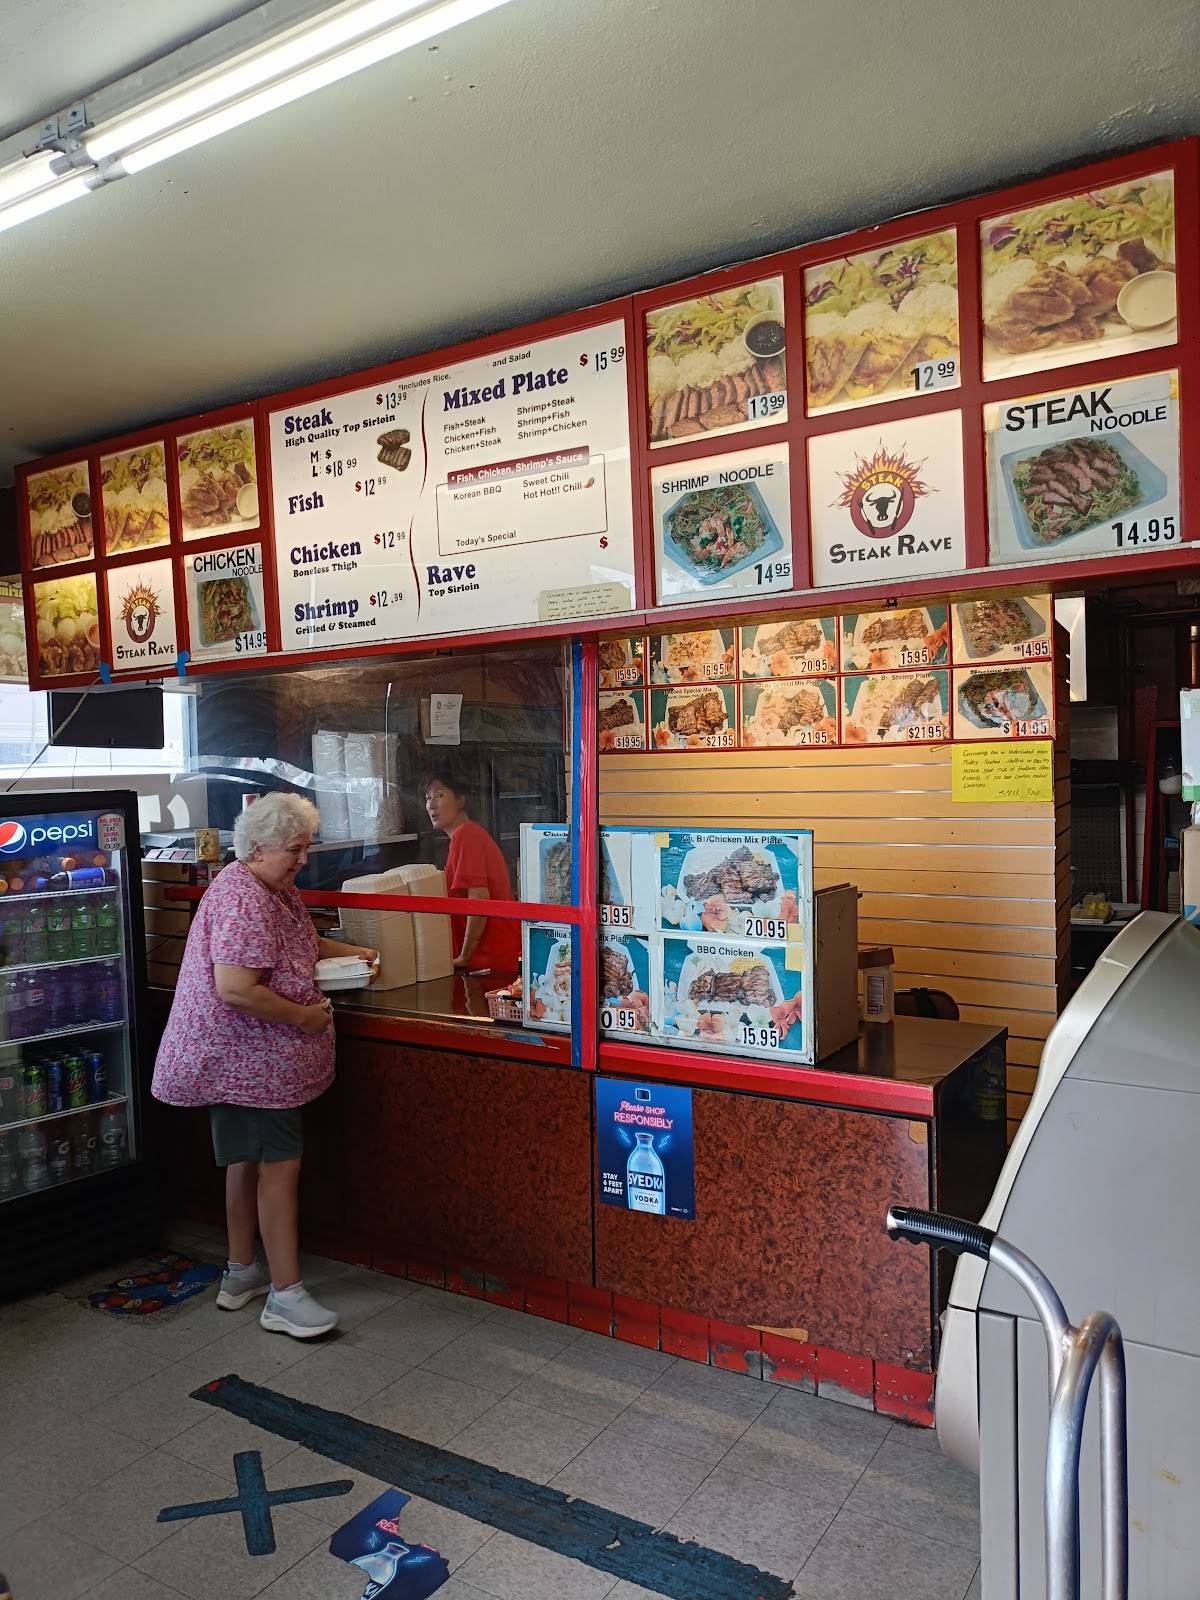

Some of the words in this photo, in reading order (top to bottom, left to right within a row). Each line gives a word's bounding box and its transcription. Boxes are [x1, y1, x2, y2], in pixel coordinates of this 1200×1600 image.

[492, 358, 506, 367] and
[508, 351, 531, 362] Salad
[443, 378, 506, 411] Mixed
[511, 367, 568, 396] Plate
[579, 353, 588, 367] $
[517, 396, 575, 416] Shrimp+Steak
[1005, 388, 1113, 432] STEAK
[285, 408, 333, 434] Steak
[443, 416, 486, 433] Fish+Steak
[517, 410, 570, 428] Shrimp+Fish
[1090, 405, 1167, 432] NOODLE
[286, 437, 305, 447] High
[308, 428, 340, 443] Quality
[343, 423, 360, 434] Top
[363, 414, 396, 428] Sirloin
[444, 426, 497, 444] Chicken+Fish
[518, 419, 587, 440] Shrimp+Chicken
[444, 437, 502, 456] Chicken+Steak
[516, 458, 554, 473] Shrimp's
[555, 453, 583, 465] Sauce
[523, 477, 548, 488] Sweet
[550, 472, 570, 483] Chili
[662, 476, 709, 494] SHRIMP
[718, 464, 774, 489] NOODLE
[862, 474, 903, 490] STEAK
[454, 490, 481, 500] Korean
[484, 486, 502, 496] BBQ
[523, 491, 538, 500] Hot
[540, 486, 560, 497] Hot!!
[562, 482, 582, 493] Chili
[288, 491, 324, 514] Fish
[456, 534, 485, 547] Today's
[487, 530, 516, 542] Special
[1111, 517, 1175, 547] 14.95
[600, 536, 608, 549] $
[193, 548, 255, 573] CHICKEN
[290, 540, 362, 565] Chicken
[232, 564, 263, 577] NOODLE
[293, 566, 329, 577] Boneless
[332, 561, 358, 572] Thigh
[427, 564, 476, 585] Rave
[429, 588, 445, 598] Top
[447, 582, 479, 594] Sirloin
[294, 598, 359, 622] Shrimp
[296, 624, 326, 635] Grilled
[328, 622, 336, 630] &
[338, 618, 376, 629] Steamed
[235, 631, 267, 653] $14.95
[30, 821, 93, 846] pepsi
[744, 836, 758, 844] Mix
[761, 836, 783, 844] Plate
[545, 931, 567, 939] Kailua
[746, 919, 785, 938] 20.95
[611, 935, 629, 943] Plate
[697, 945, 716, 955] BBQ
[718, 947, 754, 957] Chicken
[743, 1027, 778, 1048] 15.95
[620, 1101, 645, 1112] Please
[645, 1106, 665, 1115] SHOP
[614, 1112, 673, 1129] RESPONSIBLY
[603, 1186, 623, 1195] APART
[634, 1194, 659, 1204] VODKA
